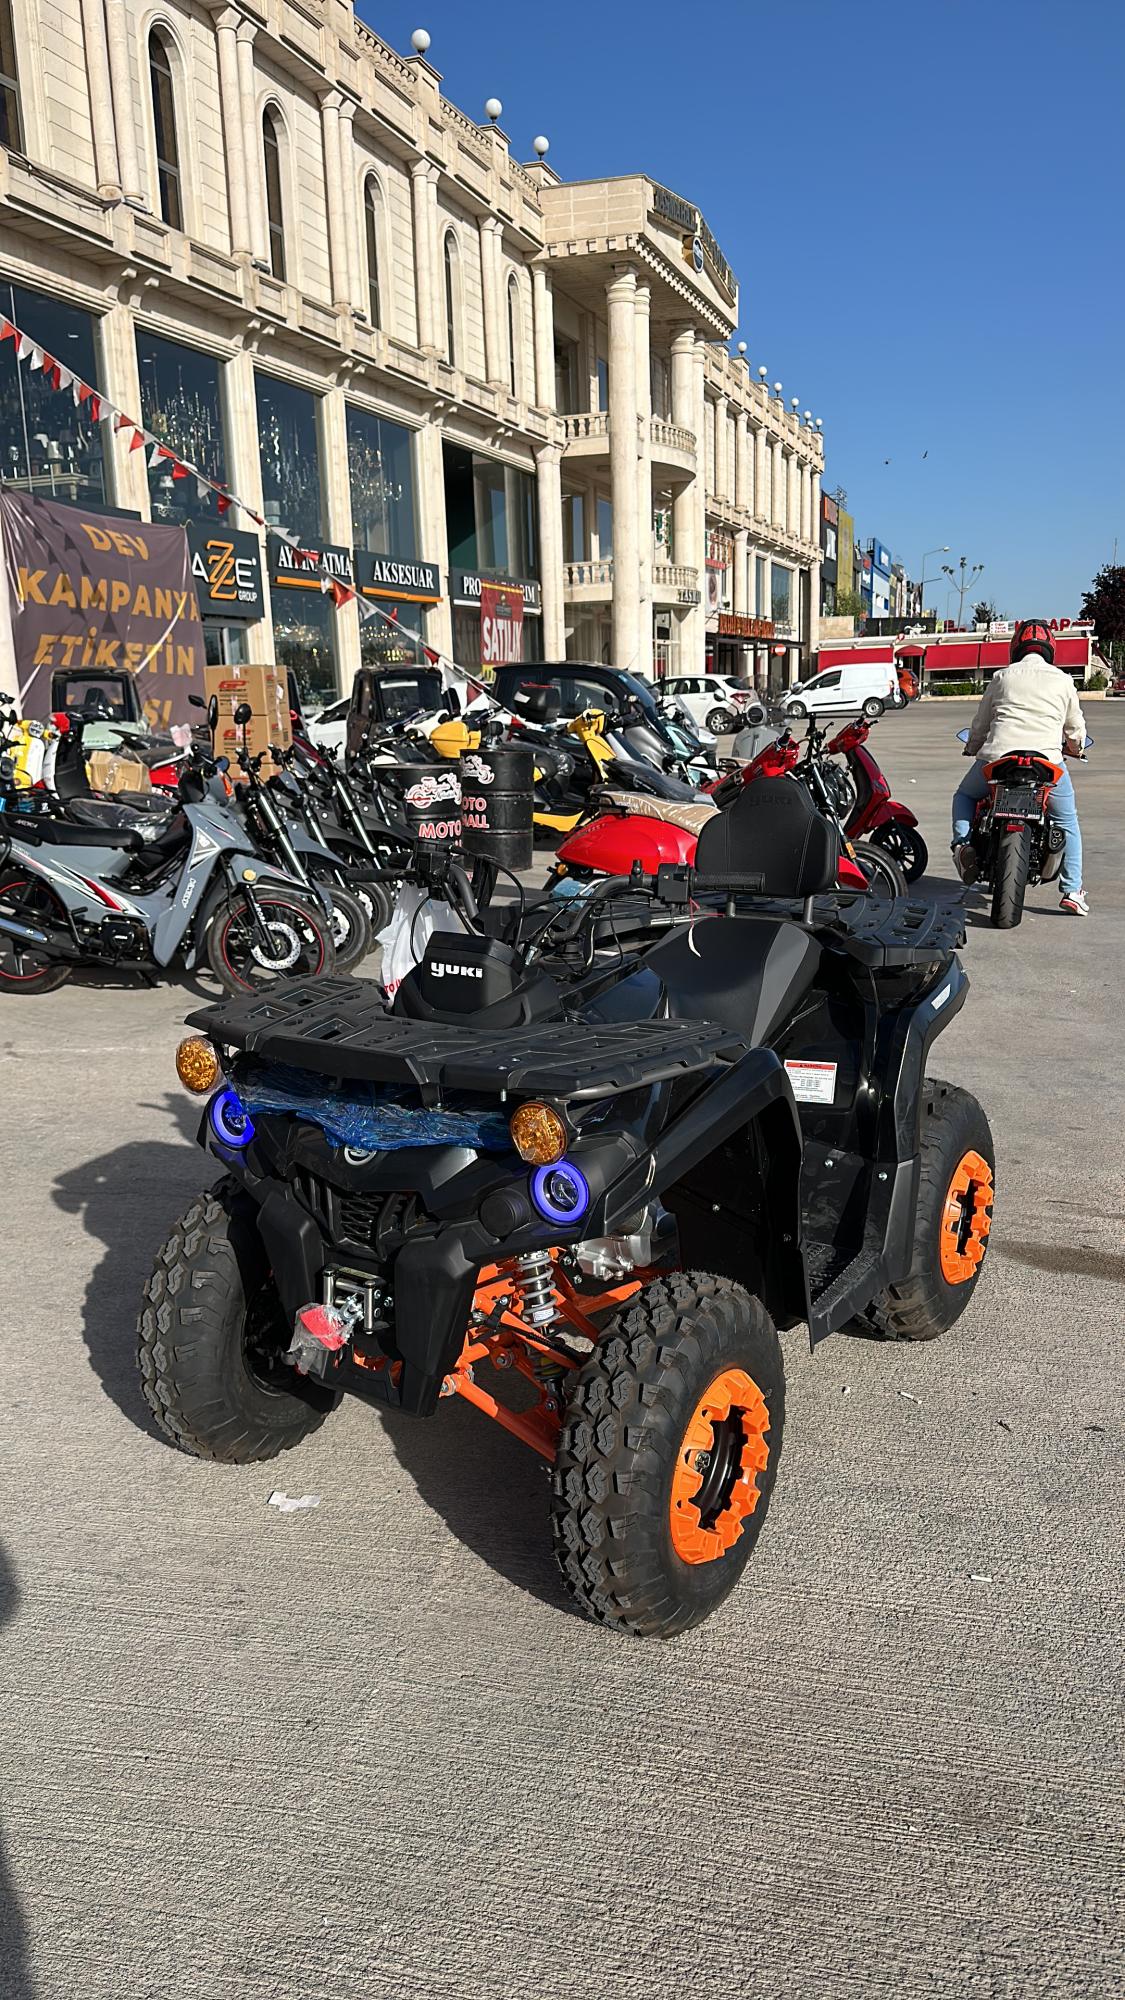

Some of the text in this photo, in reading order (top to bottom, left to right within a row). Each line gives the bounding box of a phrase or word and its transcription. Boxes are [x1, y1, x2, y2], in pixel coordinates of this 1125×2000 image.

[80, 523, 149, 560] DEV
[373, 561, 434, 589] AKSESUAR
[18, 567, 200, 622] KAMPANYA
[238, 590, 258, 602] GROUP
[33, 626, 194, 676] ETİKETİN
[461, 796, 487, 811] OTO
[430, 962, 483, 978] yuki
